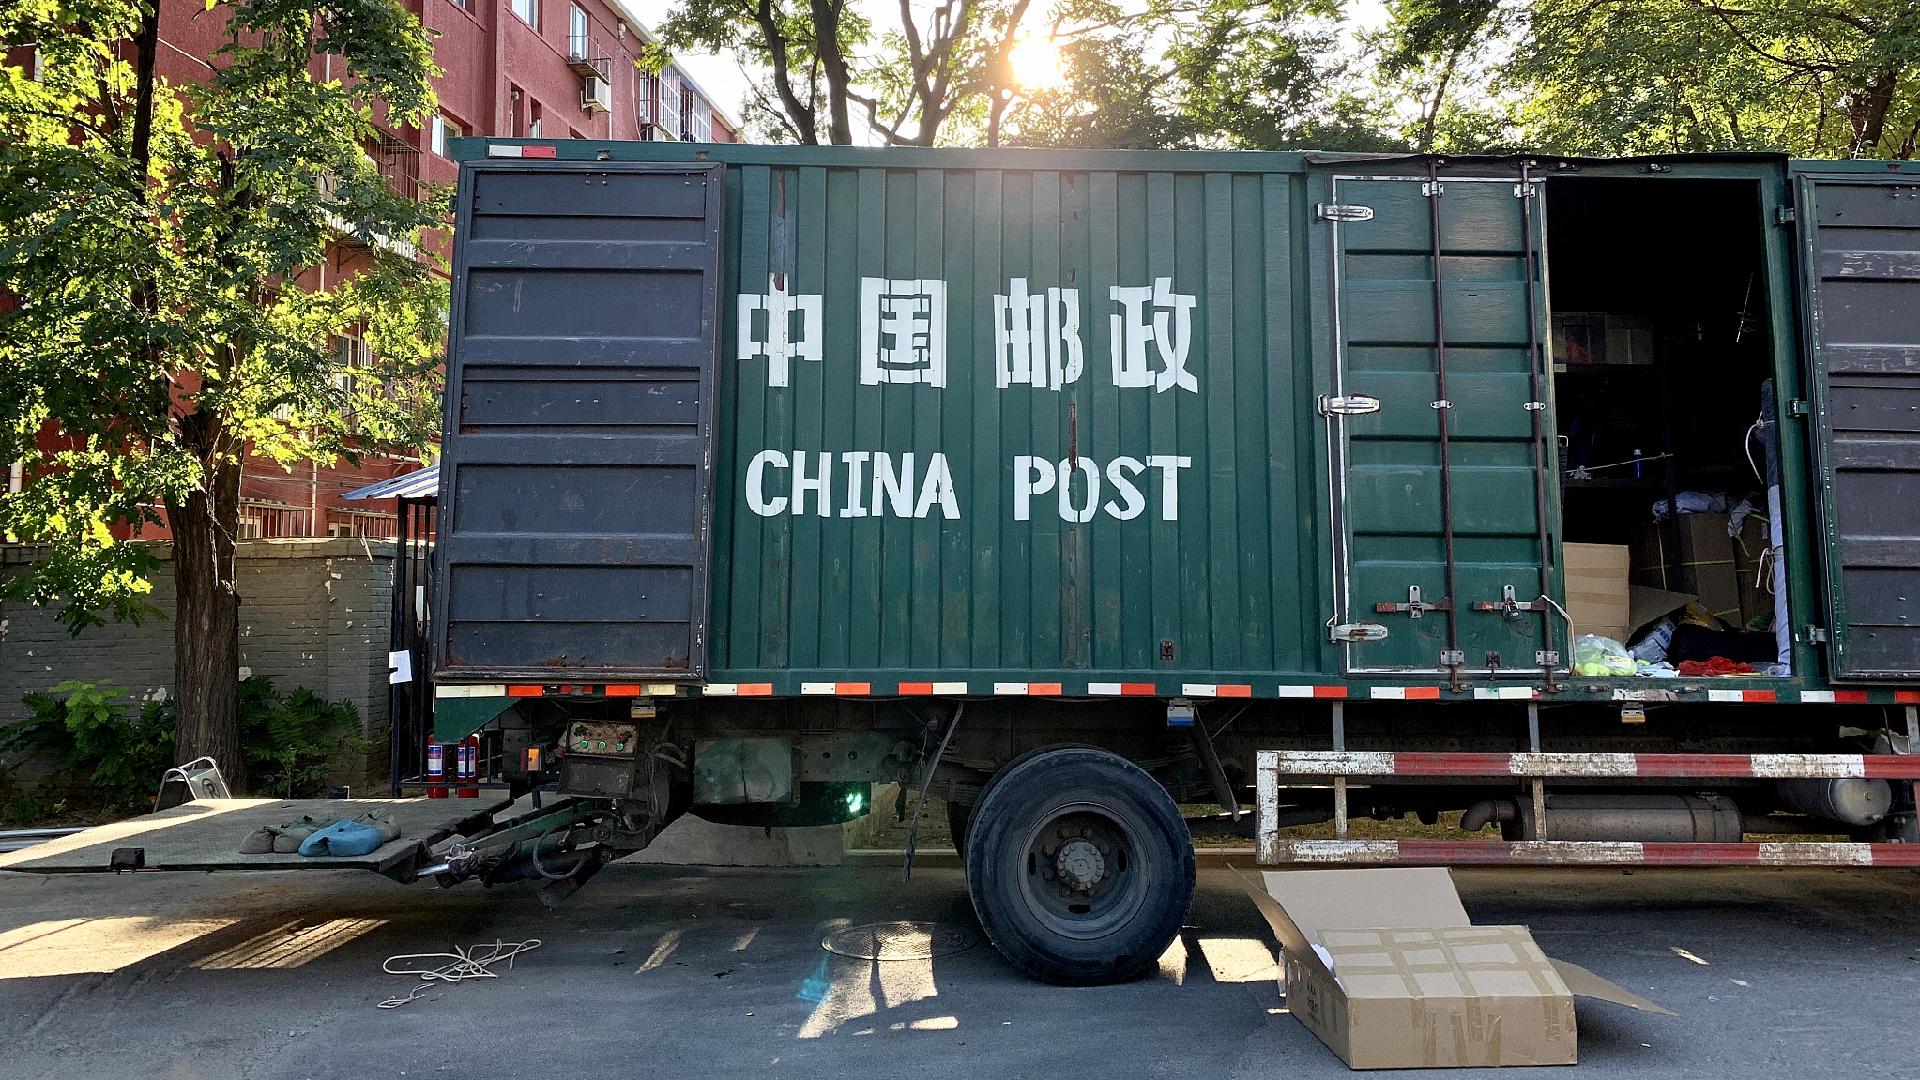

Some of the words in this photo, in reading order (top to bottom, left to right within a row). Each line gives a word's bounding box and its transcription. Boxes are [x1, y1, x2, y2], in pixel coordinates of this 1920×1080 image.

[738, 273, 1198, 393] 中国邮政
[746, 450, 960, 519] CHINA
[1014, 456, 1191, 522] POST
